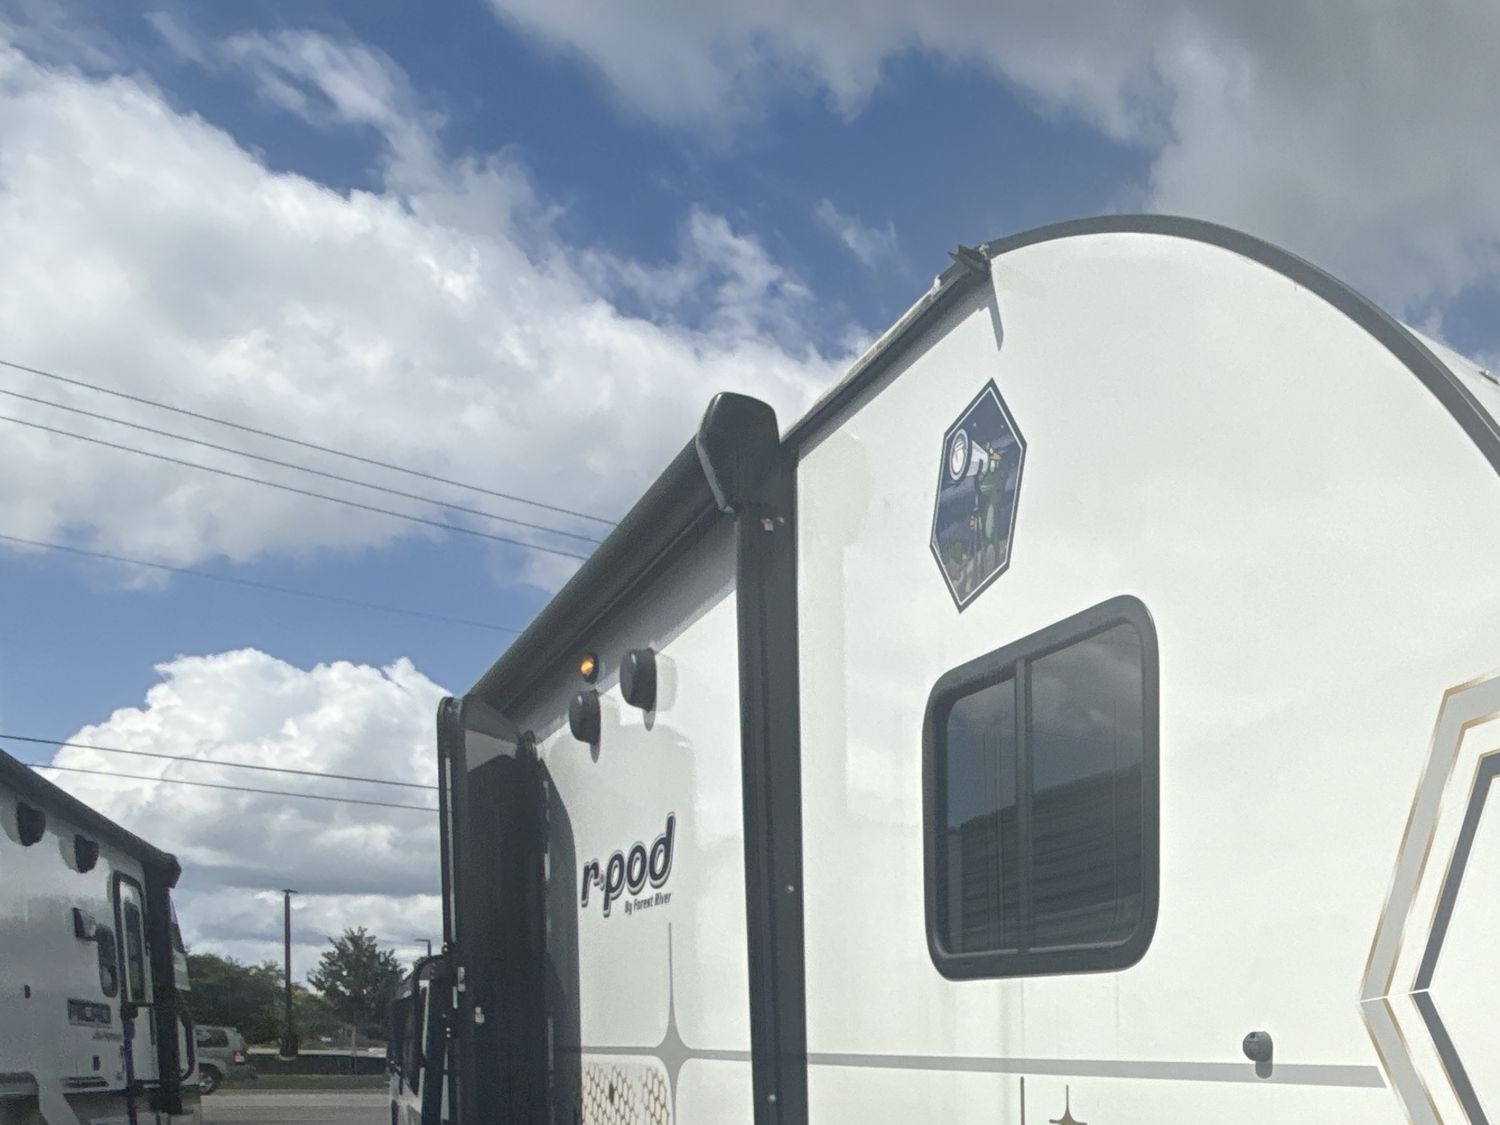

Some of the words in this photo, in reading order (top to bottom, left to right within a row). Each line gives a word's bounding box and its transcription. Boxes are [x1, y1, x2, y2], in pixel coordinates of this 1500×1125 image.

[624, 901, 633, 915] By
[633, 896, 653, 912] Forest
[654, 892, 672, 907] River
